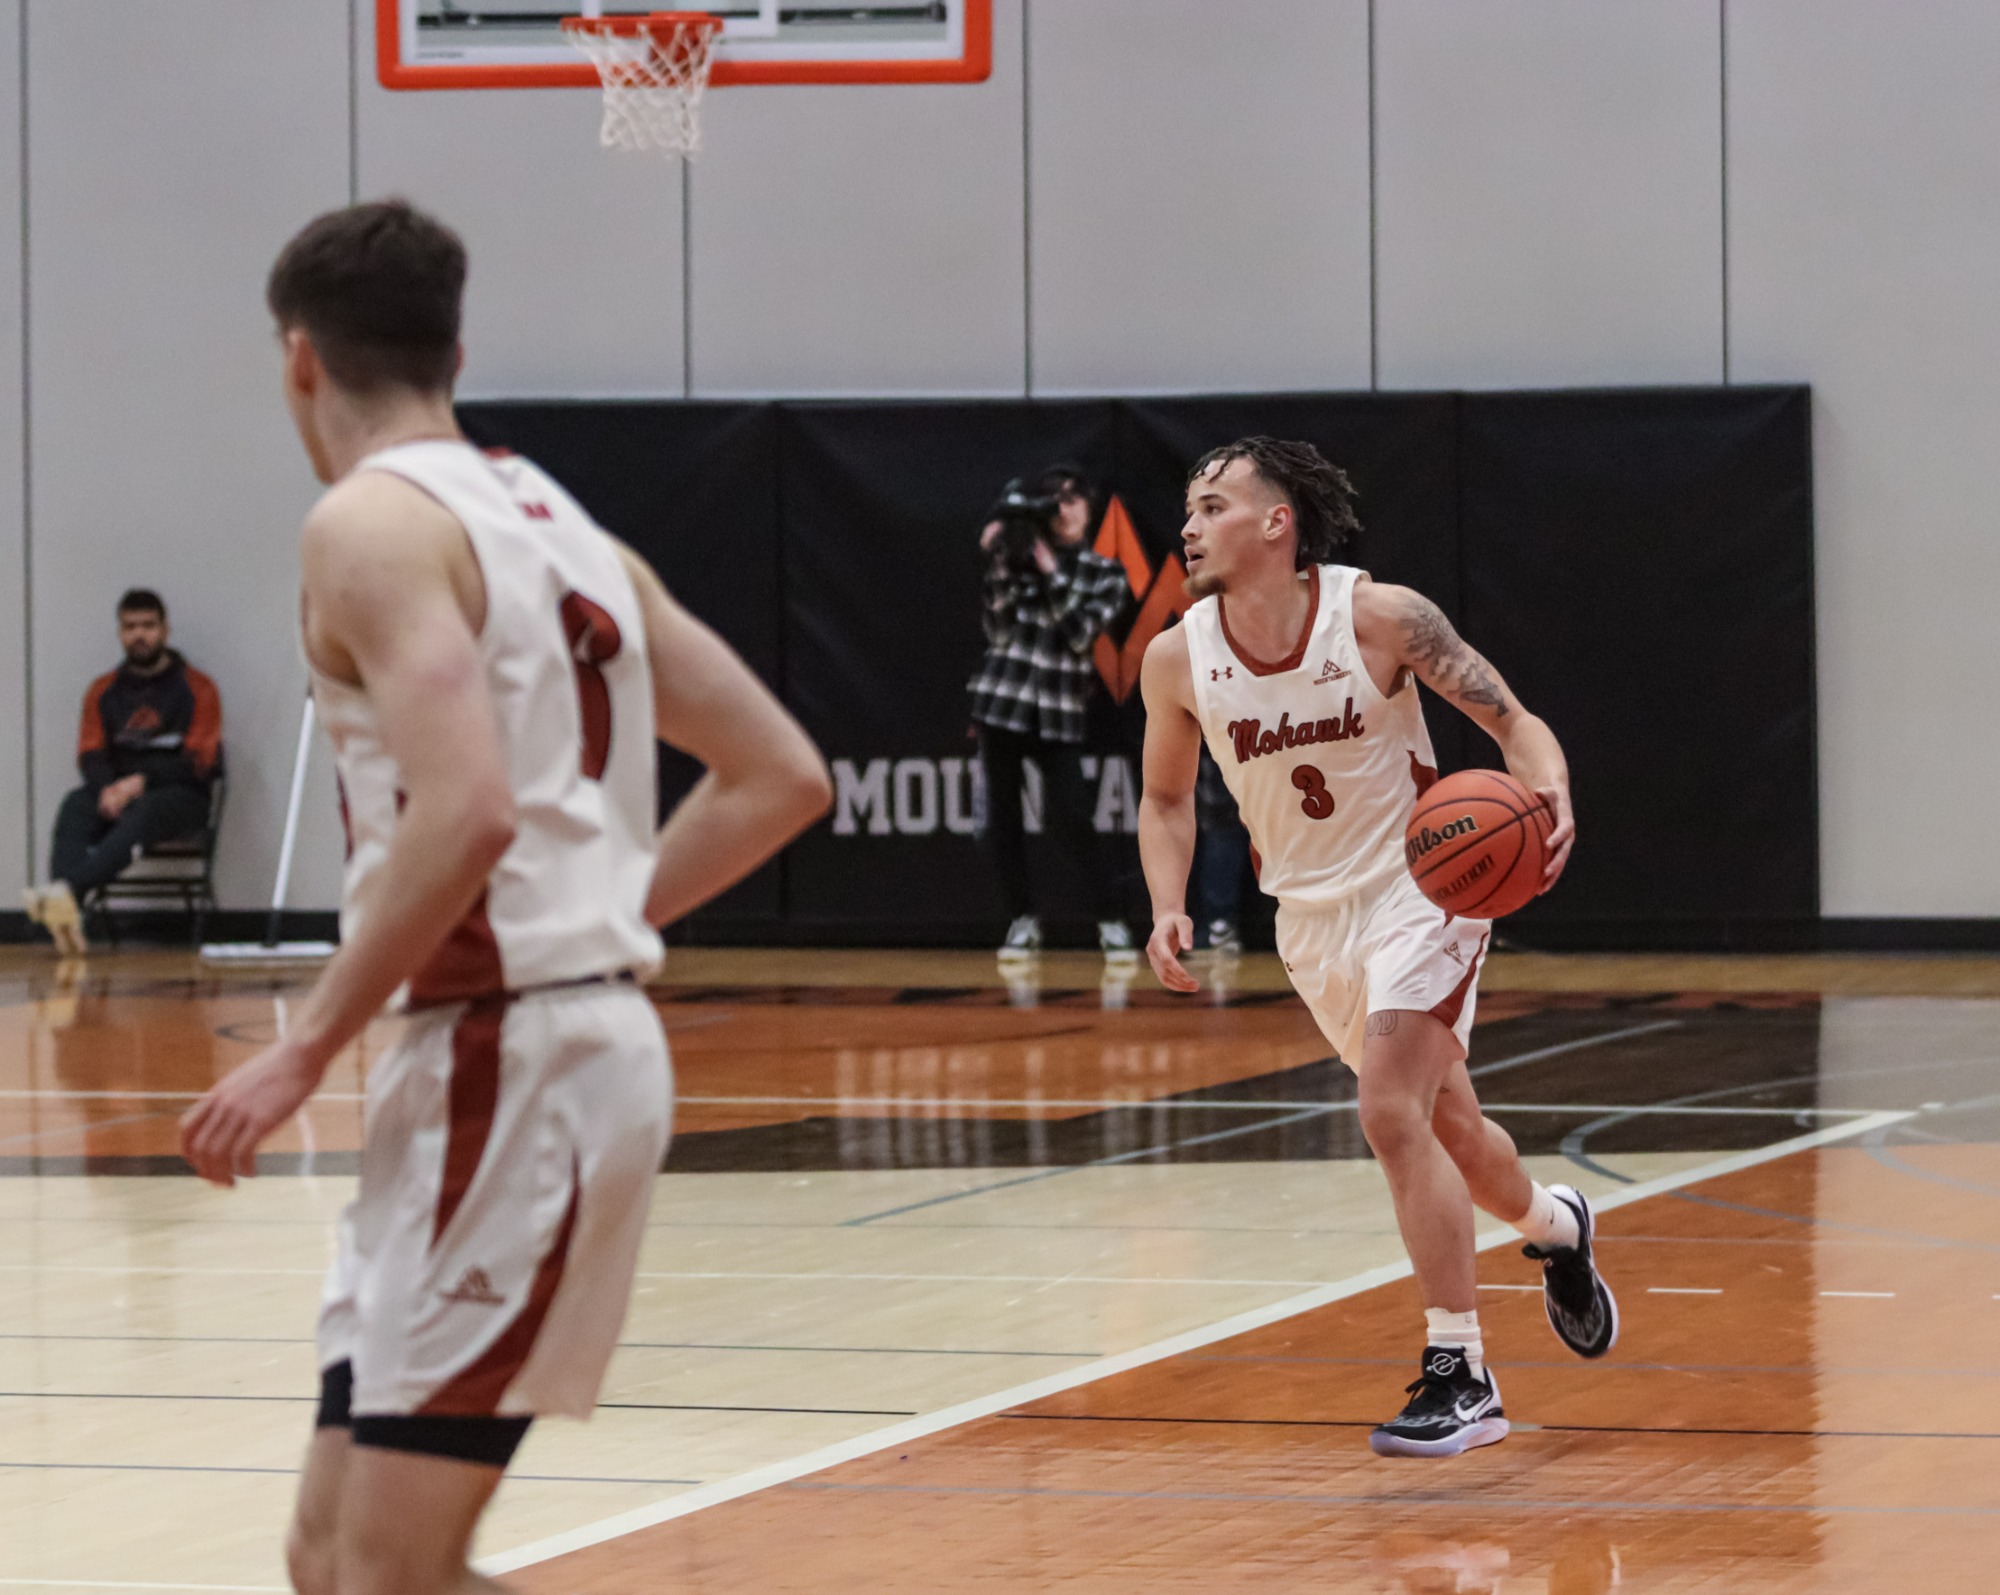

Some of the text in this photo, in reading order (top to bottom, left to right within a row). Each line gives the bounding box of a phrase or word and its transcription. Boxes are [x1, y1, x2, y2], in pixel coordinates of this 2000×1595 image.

[1228, 697, 1364, 764] Mohawk
[832, 757, 1140, 835] MOUA
[1291, 764, 1335, 820] 3
